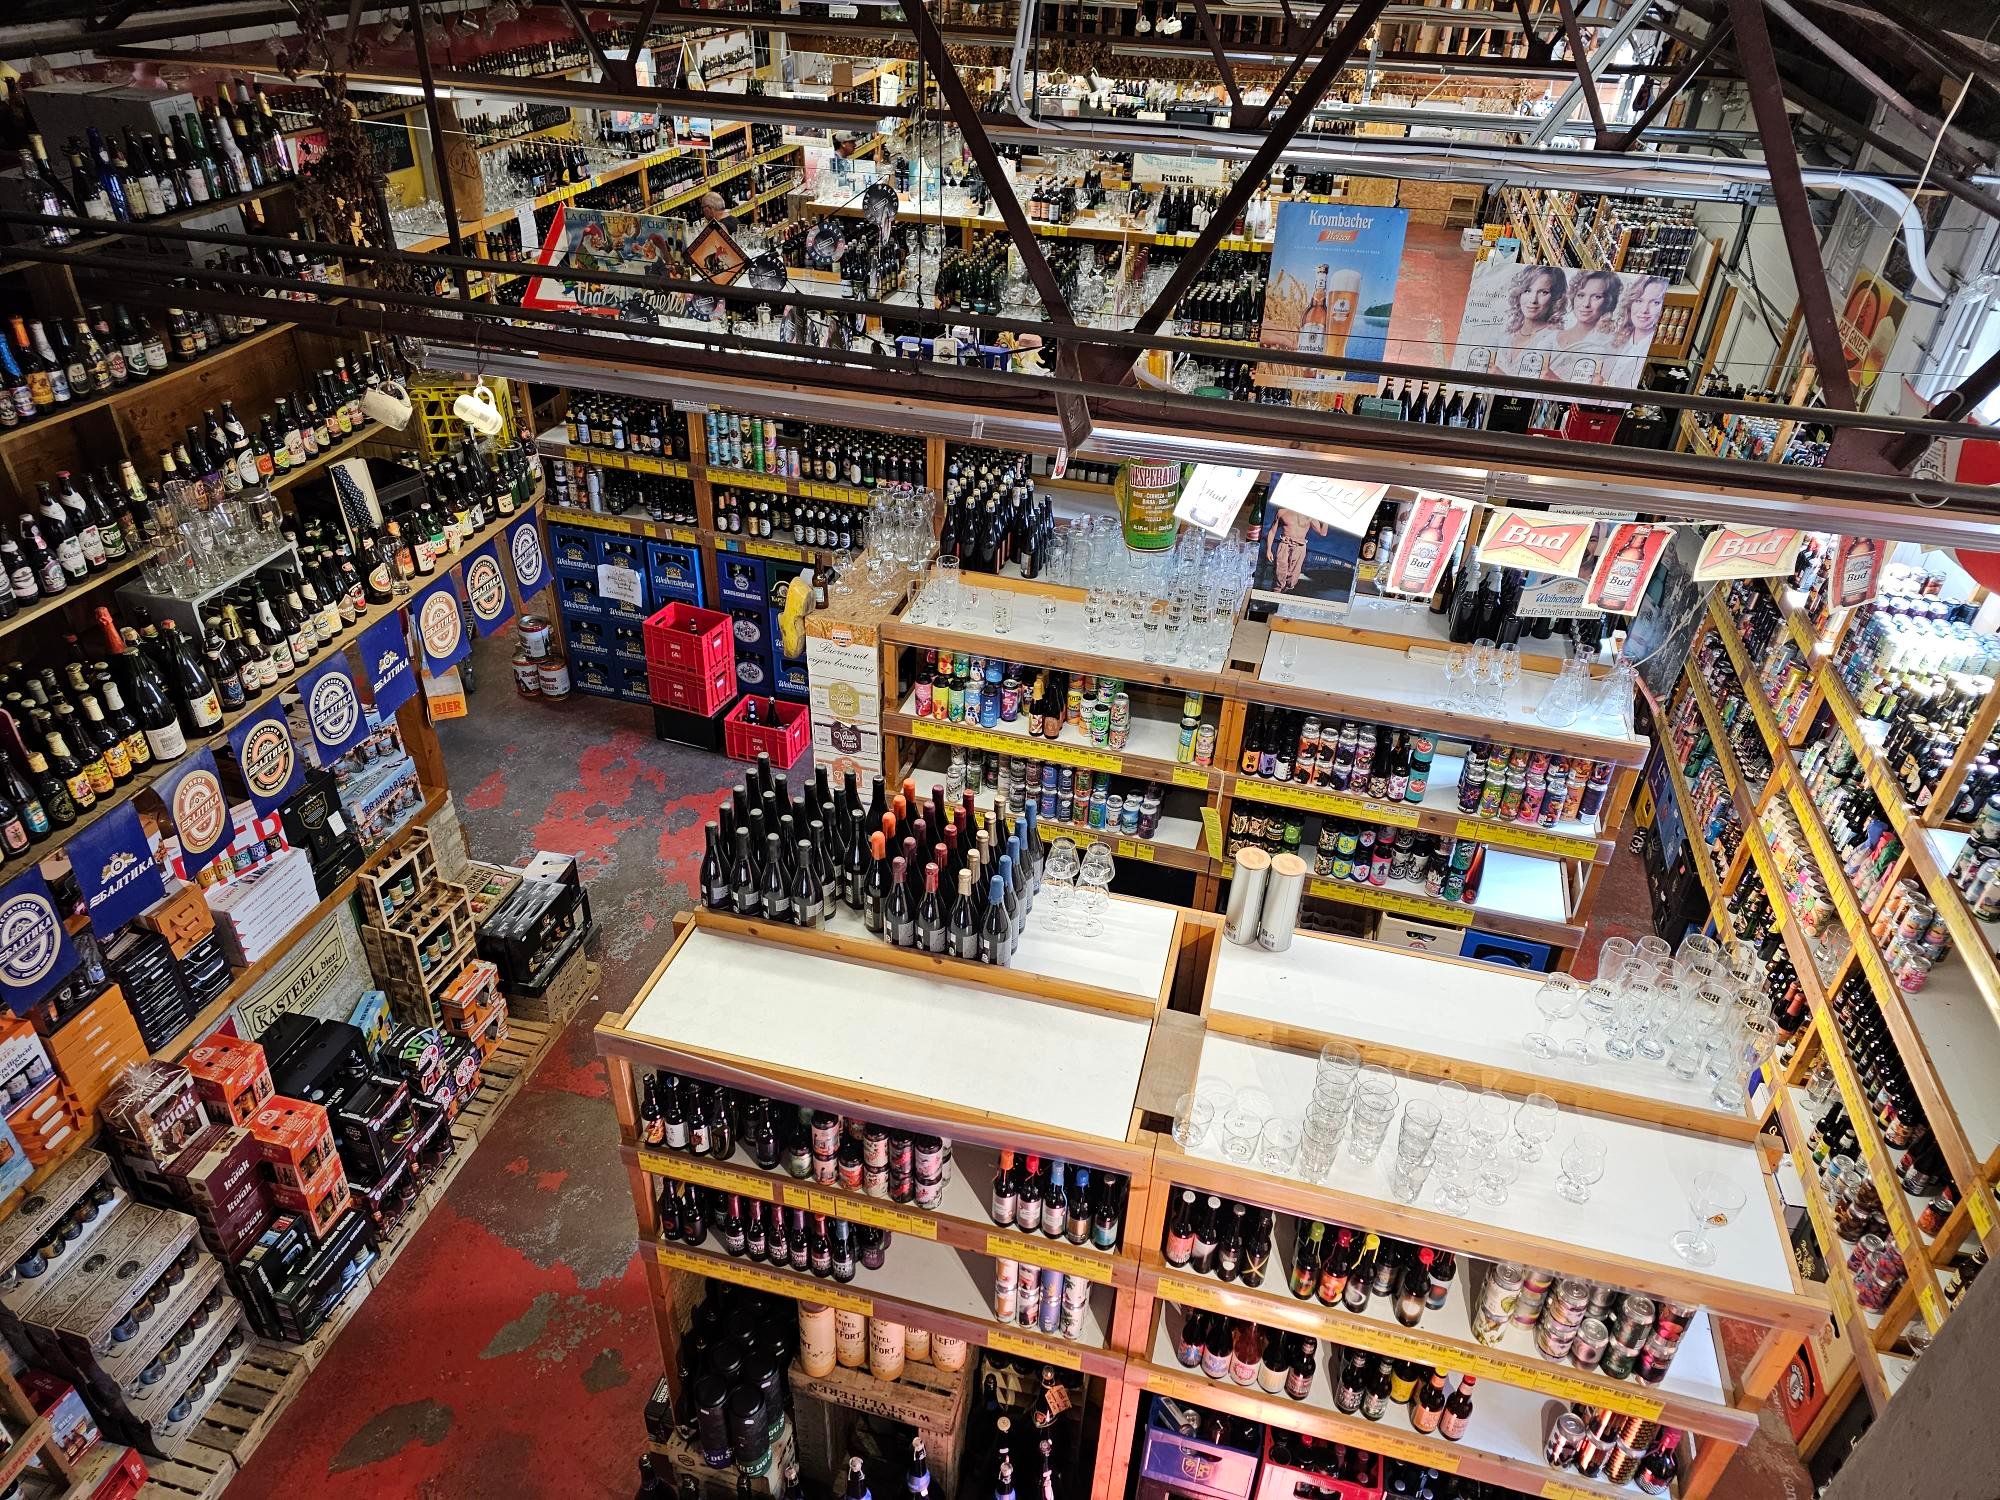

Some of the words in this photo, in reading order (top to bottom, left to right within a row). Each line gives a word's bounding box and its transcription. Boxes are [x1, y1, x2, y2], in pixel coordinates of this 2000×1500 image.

[1309, 209, 1374, 229] Krombacher
[1502, 524, 1572, 551] Bud
[1719, 535, 1785, 558] Bud
[556, 557, 597, 570] Weihenstephan
[1409, 556, 1431, 569] Bud
[1847, 570, 1868, 582] Bud
[654, 575, 696, 590] Weihenstephan
[1609, 574, 1631, 588] Bud
[563, 599, 602, 614] Weihenstephan
[570, 640, 609, 654] Weihenstephan
[816, 641, 852, 658] Bieren
[853, 650, 869, 660] uit
[374, 657, 409, 692] БАЛТИКА
[808, 656, 833, 669] eigen
[833, 657, 875, 677] brouwerij
[577, 680, 616, 693] Weihenstephan
[315, 693, 352, 725] БАЛТИКА
[433, 699, 462, 715] BIER
[248, 740, 289, 777] БАЛТИКА
[363, 773, 408, 816] BRANDARIS
[181, 793, 220, 832] БАЛТИКА
[90, 855, 156, 909] БАЛТИКА
[0, 916, 53, 963] БАЛТИКА
[256, 965, 319, 1029] KASTEEL
[321, 951, 337, 970] bier
[299, 964, 340, 1008] INGELMUNSTER
[151, 1091, 196, 1138] kwak
[224, 1159, 251, 1191] kwak
[227, 1181, 253, 1214] kwak
[238, 1209, 264, 1241] kwak
[808, 1382, 931, 1423] WESTVLETEREN
